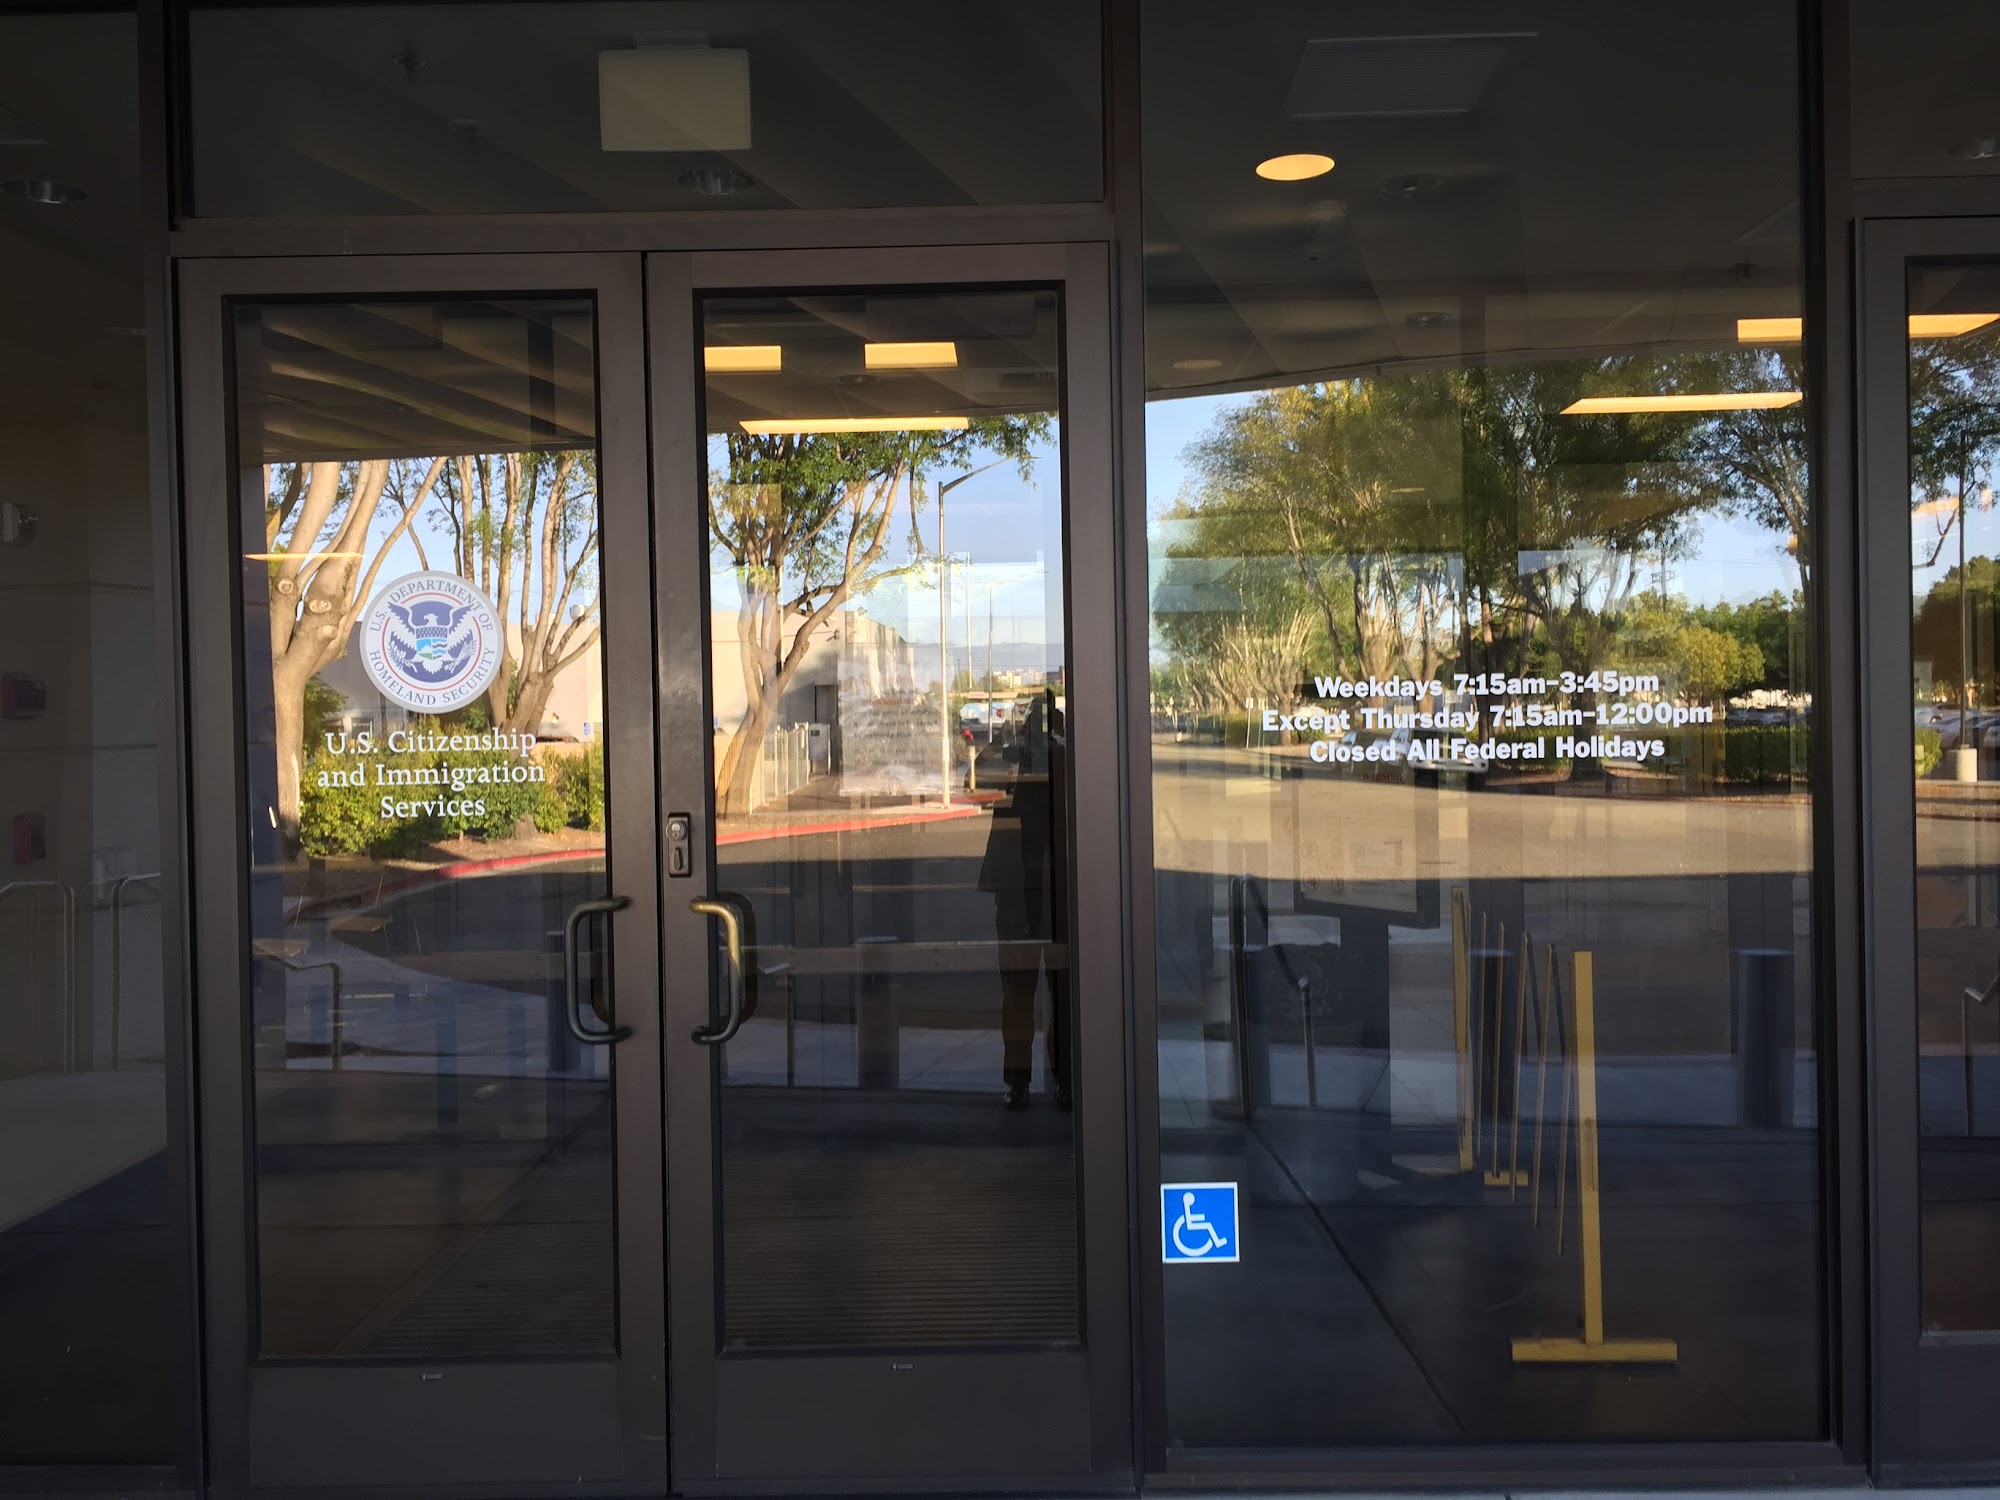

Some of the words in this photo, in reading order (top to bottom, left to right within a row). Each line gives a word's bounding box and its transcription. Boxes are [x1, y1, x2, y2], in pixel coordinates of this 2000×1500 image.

[370, 610, 388, 632] U.S.
[389, 579, 483, 612] DEPARTMENT
[478, 613, 493, 631] OF
[370, 650, 436, 705] HOMELAND
[443, 647, 495, 703] SECURITY
[1314, 674, 1443, 700] Weekdays
[1453, 671, 1659, 697] 7:15am-3:45pm
[1262, 708, 1350, 734] Except
[1360, 705, 1479, 733] Thursday
[1490, 702, 1713, 728] 7:15am-12:00pm
[325, 732, 378, 754] U.S.
[388, 728, 537, 758] Citizenship
[1309, 738, 1396, 763] Closed
[1407, 737, 1440, 760] All
[1451, 736, 1544, 761] Federal
[1555, 735, 1665, 761] Holidays
[317, 763, 365, 787] and
[375, 761, 545, 792] Immigration
[381, 795, 485, 818] Services
